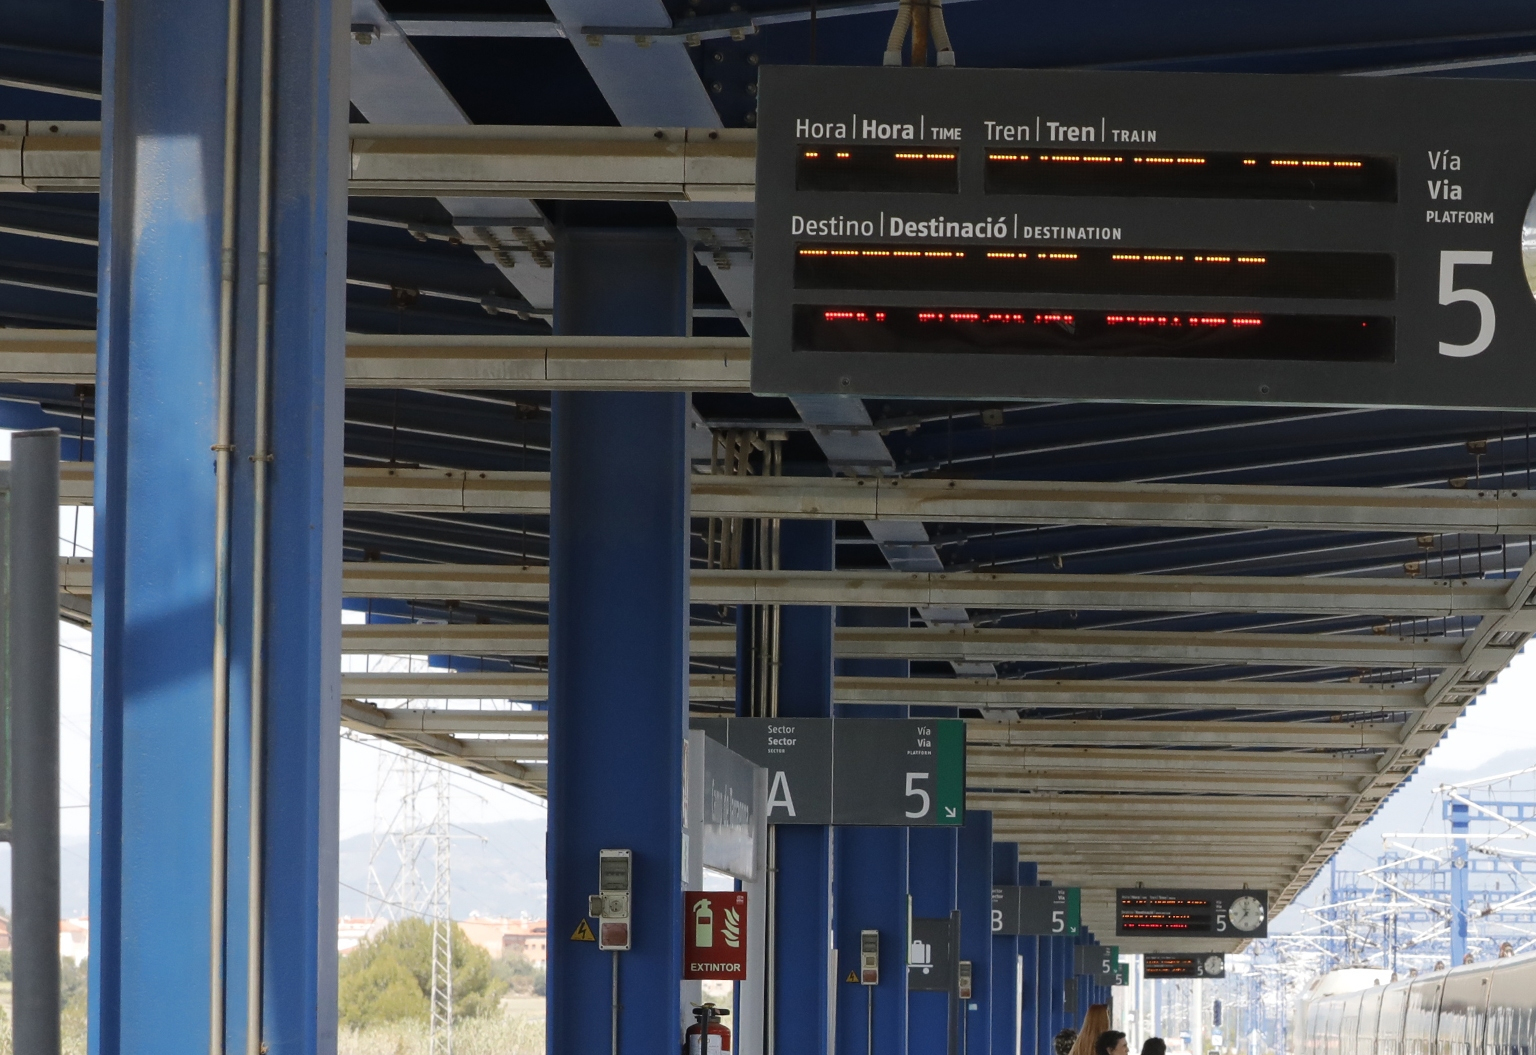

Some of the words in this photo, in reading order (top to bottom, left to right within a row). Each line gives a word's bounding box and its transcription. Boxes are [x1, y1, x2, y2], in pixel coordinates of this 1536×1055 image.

[796, 118, 846, 139] Hora
[862, 119, 914, 140] Hora
[931, 127, 962, 141] TIME
[984, 121, 1030, 141] Tren
[1046, 122, 1095, 142] Tren
[1111, 130, 1157, 143] TRAIN
[1427, 150, 1461, 171] Vía
[1427, 180, 1462, 201] Via
[791, 215, 874, 236] Destino
[890, 216, 1008, 239] Destinació
[1023, 226, 1122, 240] DESTINATION
[1426, 210, 1495, 225] PLATFORM
[1438, 250, 1496, 358] 5
[767, 724, 796, 734] Sector
[917, 725, 931, 736] Vía
[768, 736, 797, 746] Sector
[917, 738, 932, 748] Via
[766, 770, 797, 817] A
[904, 772, 931, 819] 5
[991, 909, 1003, 932] B
[1051, 910, 1065, 933] 5
[1216, 914, 1227, 932] 5
[690, 962, 741, 972] EXTINTOR
[1102, 960, 1111, 974] 5
